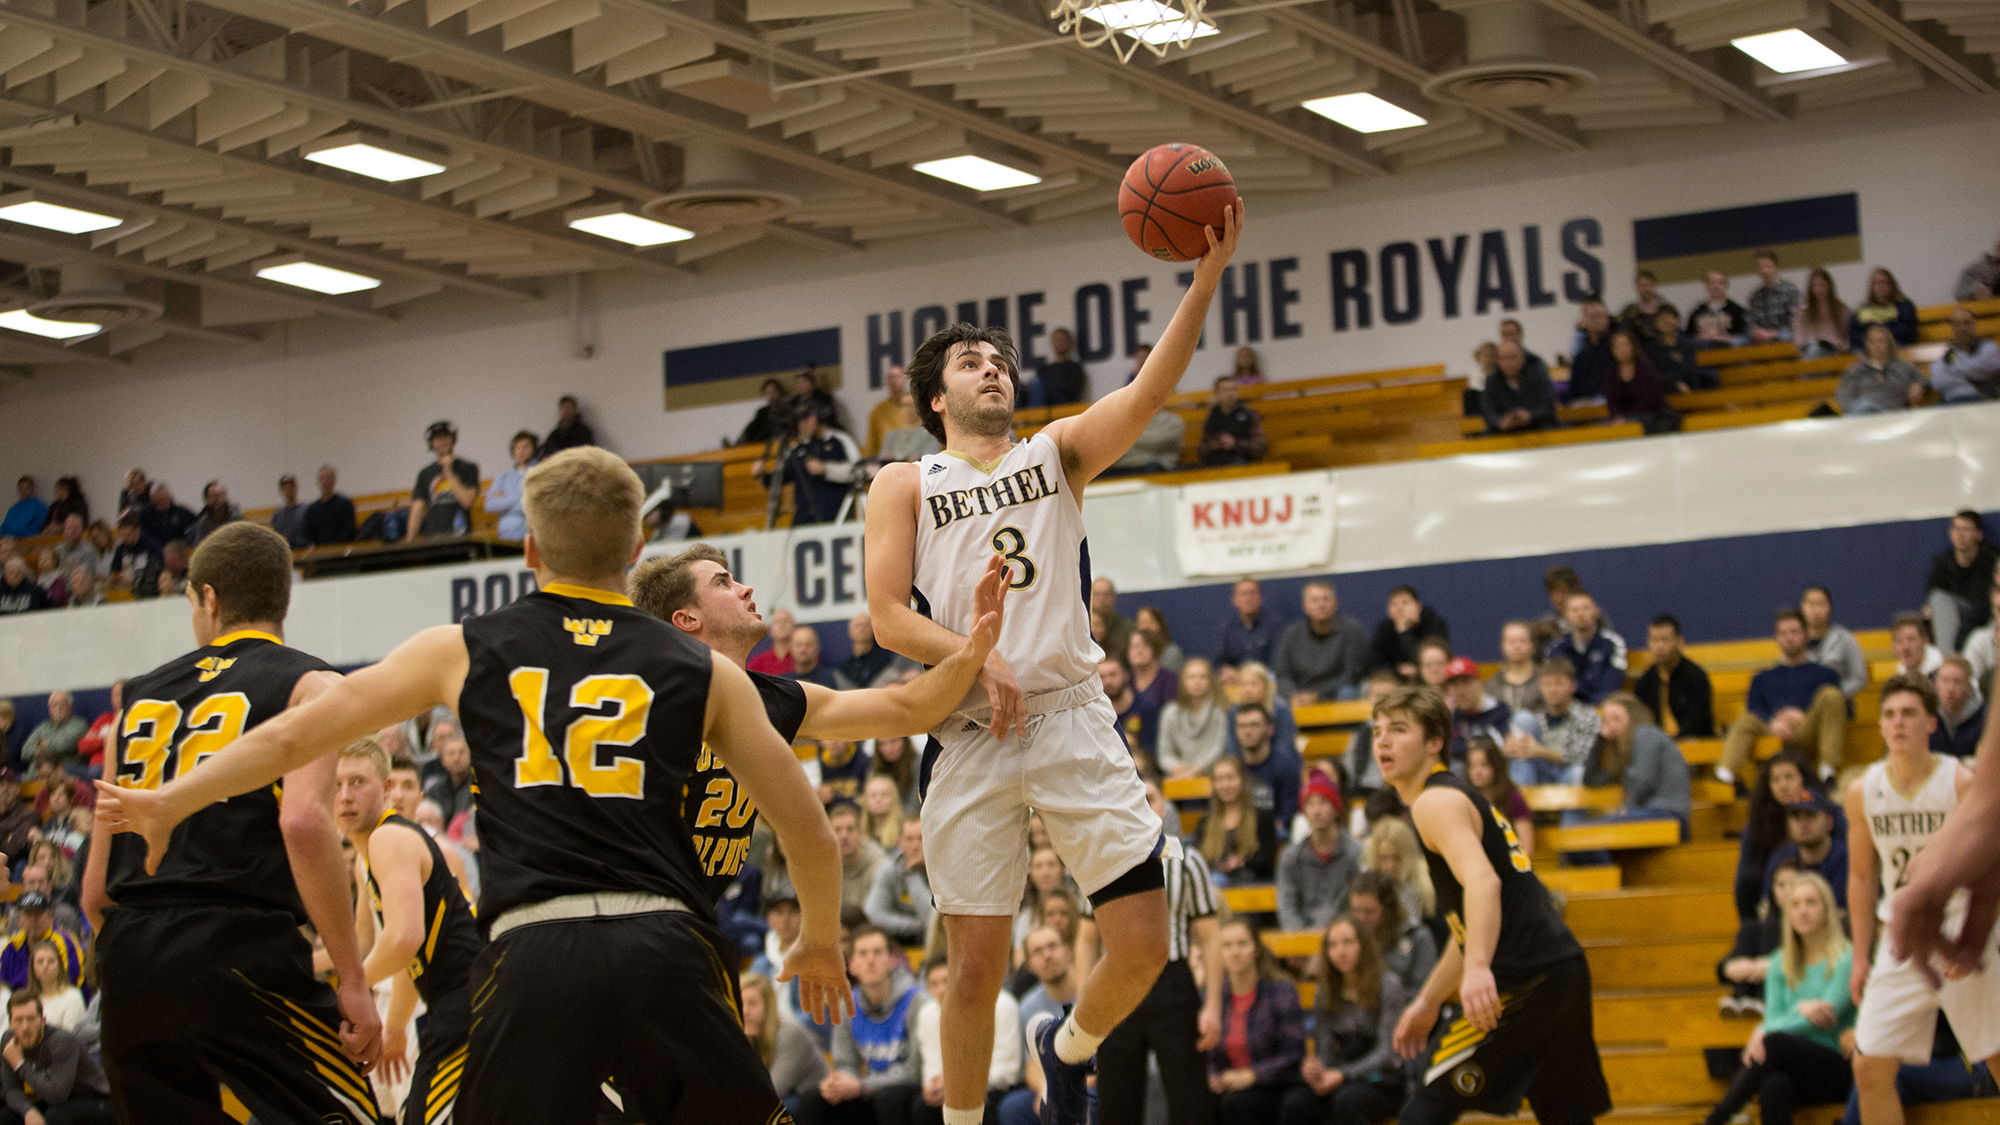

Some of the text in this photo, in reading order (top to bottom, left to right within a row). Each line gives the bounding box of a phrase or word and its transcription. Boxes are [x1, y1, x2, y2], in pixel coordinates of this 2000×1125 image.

[1076, 277, 1151, 364] OF
[1329, 218, 1605, 332] ROYALS
[926, 463, 1059, 530] BETHEL
[1192, 494, 1293, 530] KNUJ
[990, 525, 1037, 591] 3
[118, 691, 252, 797] 32
[508, 666, 655, 800] 12
[695, 778, 756, 828] 20
